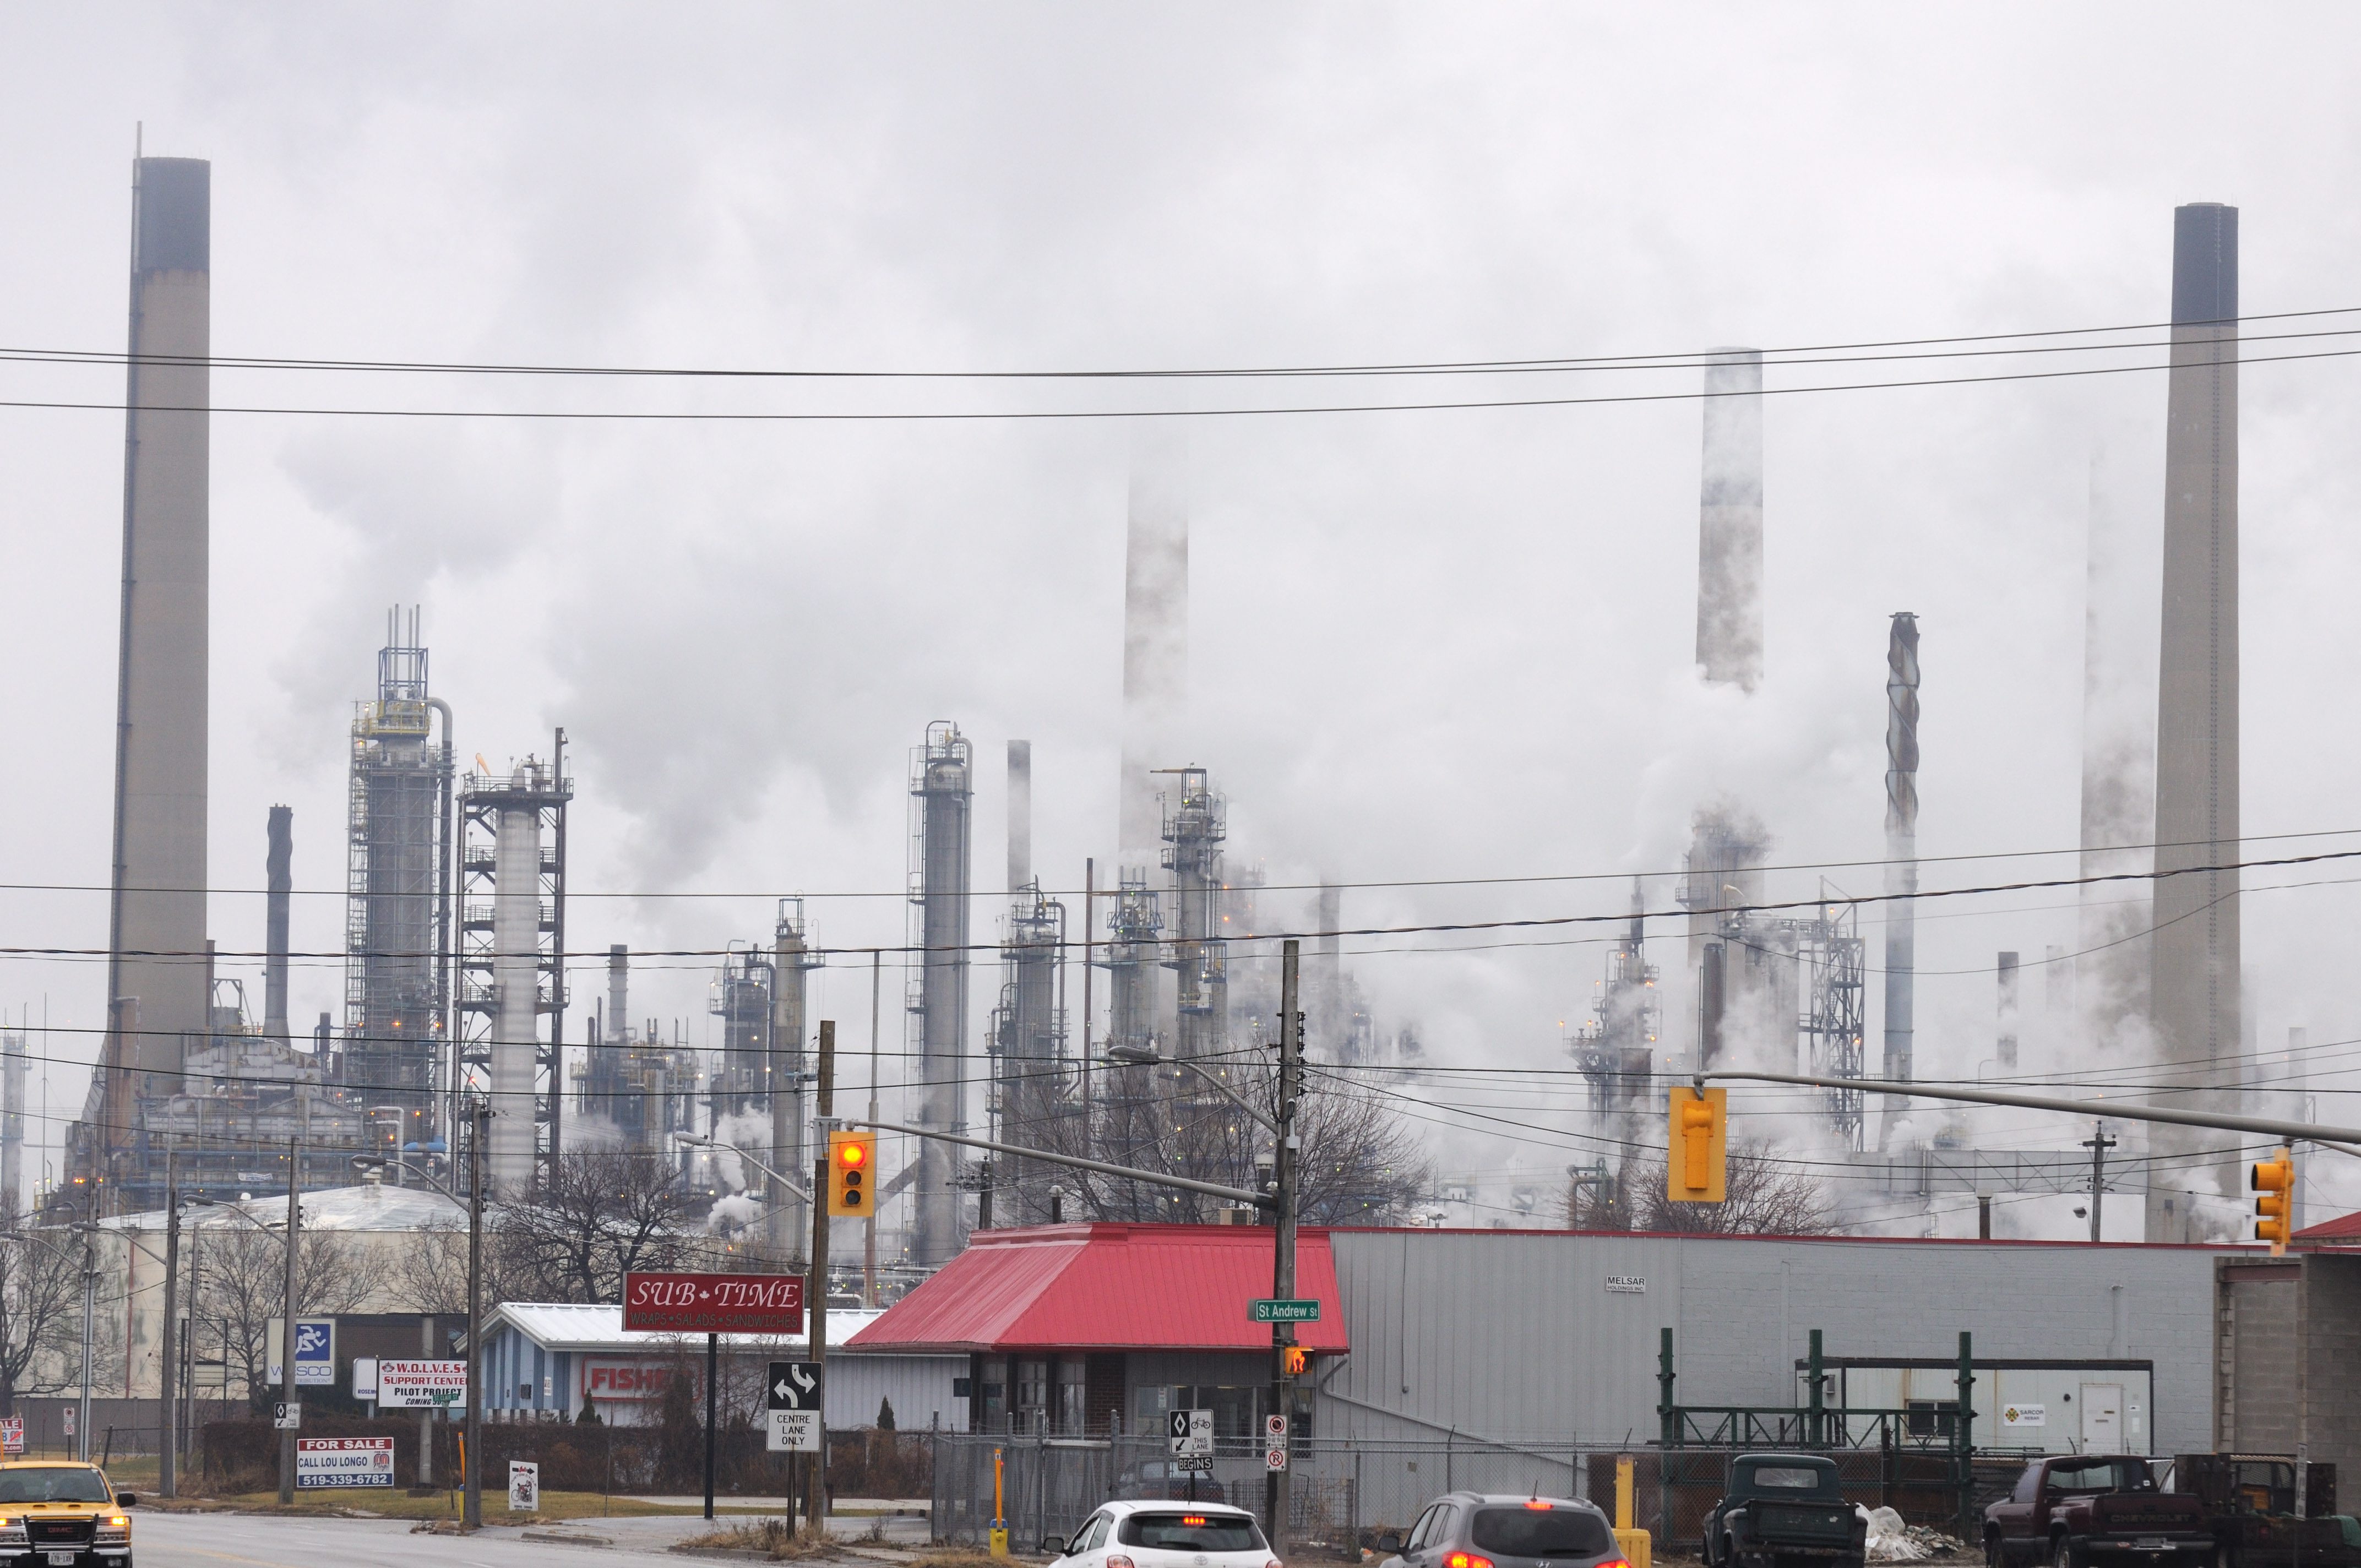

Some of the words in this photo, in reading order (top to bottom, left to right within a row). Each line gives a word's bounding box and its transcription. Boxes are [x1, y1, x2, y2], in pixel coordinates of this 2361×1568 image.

[1608, 1277, 1645, 1286] MELSAR
[631, 1281, 696, 1306] SUB
[715, 1280, 798, 1308] TIME
[1259, 1304, 1269, 1317] St
[1272, 1304, 1307, 1317] Andrew
[1310, 1307, 1318, 1316] St
[630, 1312, 667, 1325] WRAPS
[676, 1313, 716, 1326] SALADS
[725, 1314, 798, 1328] SANDWICHES
[270, 1366, 331, 1376] WSCO
[396, 1363, 461, 1373] W.O.L.V.E.S
[384, 1376, 431, 1385] SUPPORT
[394, 1387, 420, 1396] PILOT
[777, 1415, 810, 1423] CENTRE
[782, 1426, 806, 1434] LANE
[306, 1441, 339, 1449] FOR
[344, 1440, 385, 1449] SALE
[782, 1436, 805, 1445] ONLY
[298, 1458, 318, 1468] CALL
[321, 1457, 337, 1467] LOU
[340, 1457, 367, 1467] LONGO
[1179, 1461, 1211, 1469] BEGINS
[303, 1474, 387, 1485] 519-339-6782
